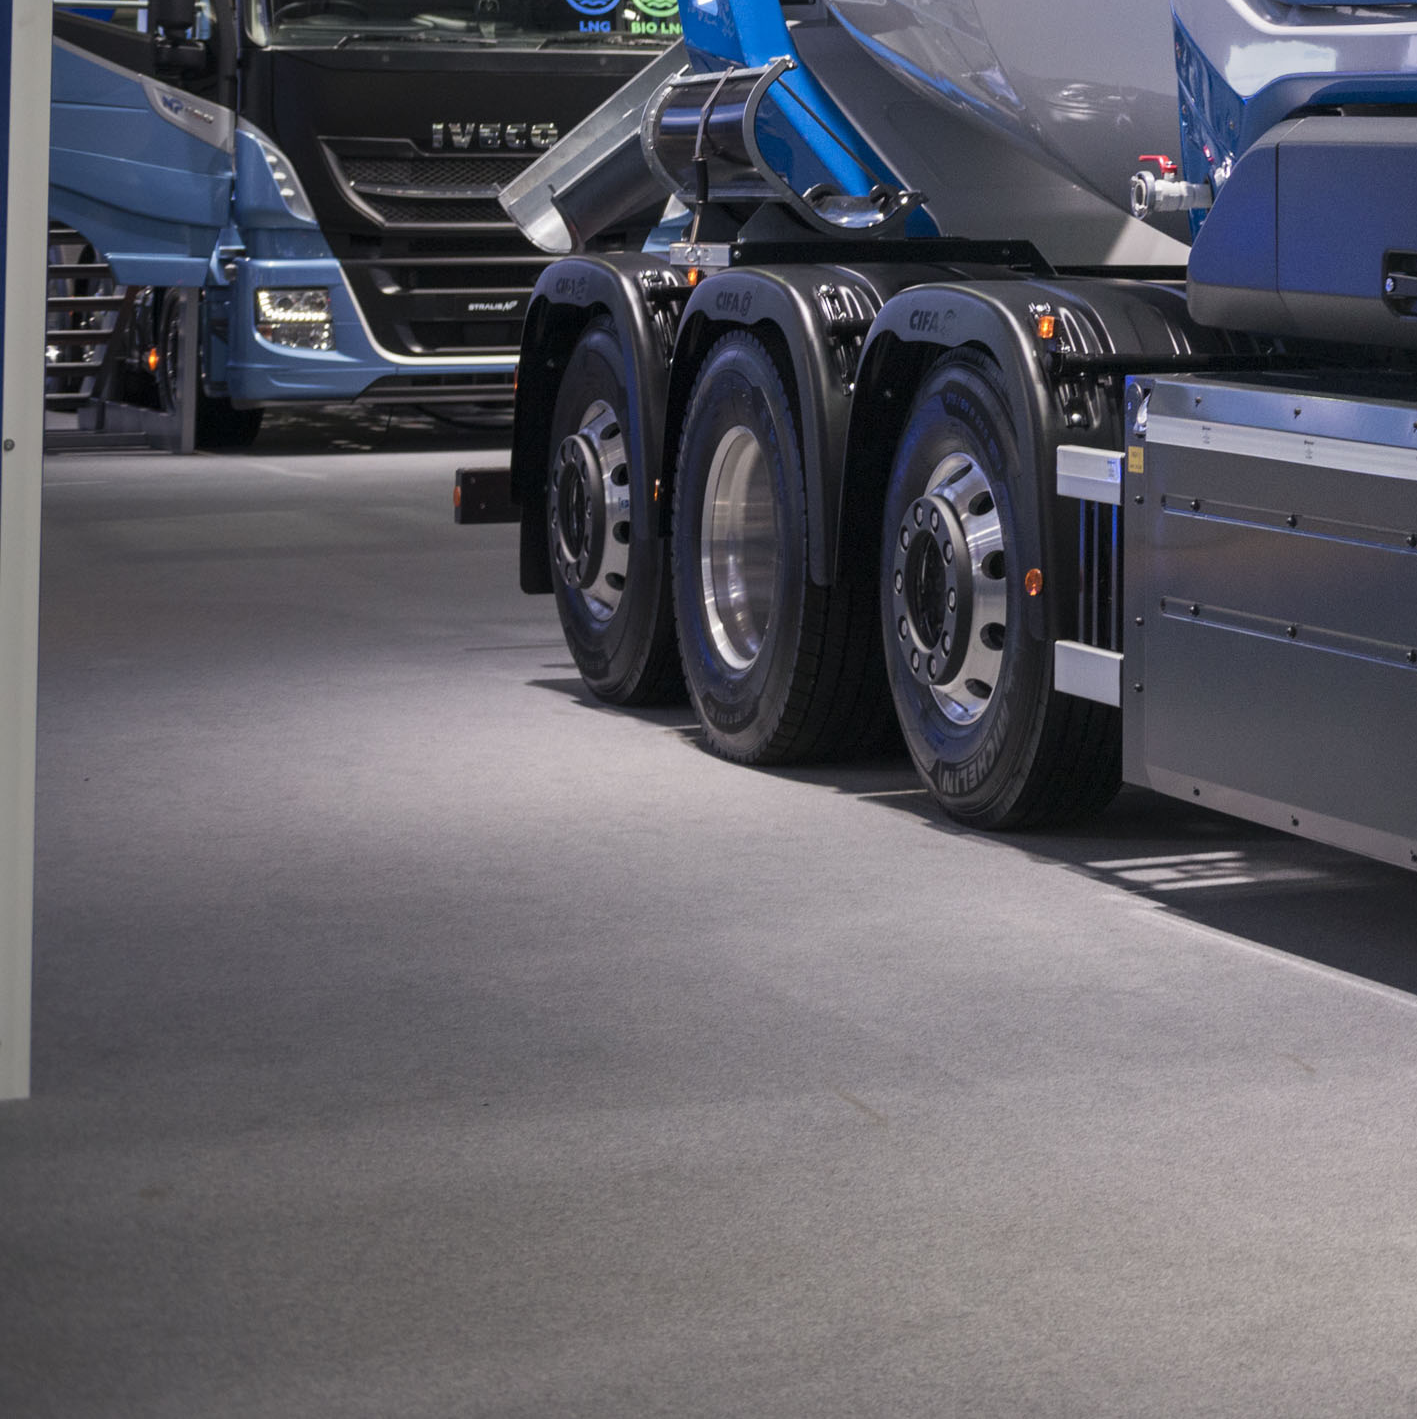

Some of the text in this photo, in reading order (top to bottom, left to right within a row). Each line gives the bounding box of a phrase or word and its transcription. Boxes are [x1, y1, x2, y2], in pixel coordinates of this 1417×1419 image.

[579, 21, 611, 33] LNG
[631, 22, 683, 34] BIO LN
[432, 122, 559, 149] IVECO
[716, 291, 739, 311] CIFA
[910, 310, 938, 333] CIFA
